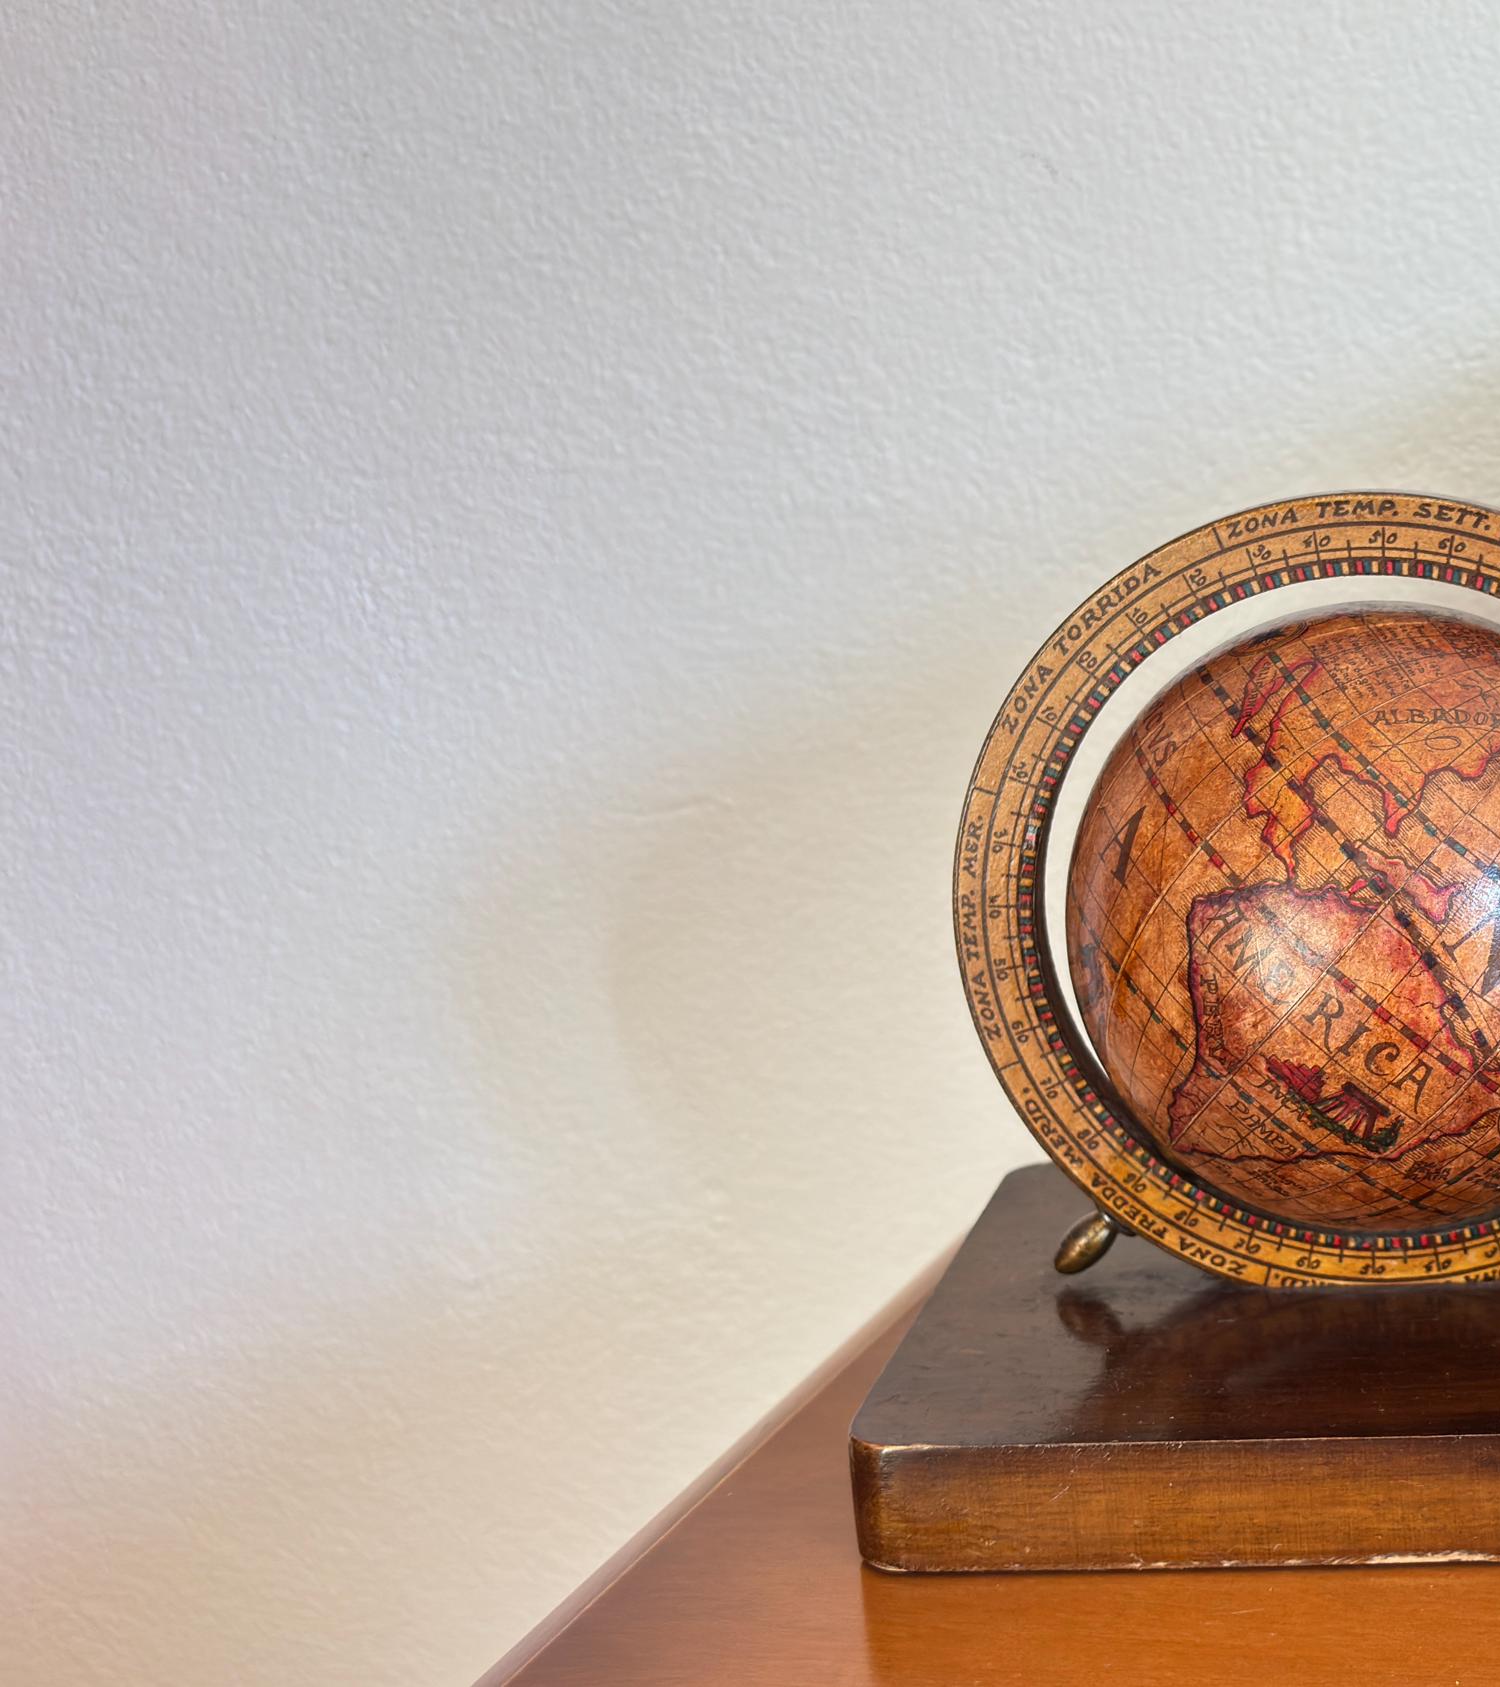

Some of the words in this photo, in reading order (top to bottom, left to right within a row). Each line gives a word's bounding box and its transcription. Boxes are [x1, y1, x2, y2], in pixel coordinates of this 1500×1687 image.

[1222, 506, 1299, 541] ZONA
[1315, 499, 1397, 519] TEMP.
[1414, 501, 1494, 532] SETT.
[997, 660, 1053, 734] ZONA
[1050, 559, 1163, 657] TORRIDA
[962, 813, 984, 877] MER.
[961, 889, 981, 962] TEMP.
[969, 969, 1003, 1041] ZONA
[1017, 1085, 1085, 1169] MERID.
[1086, 1171, 1168, 1240] FREDDA
[1173, 1236, 1246, 1279] ZONA
